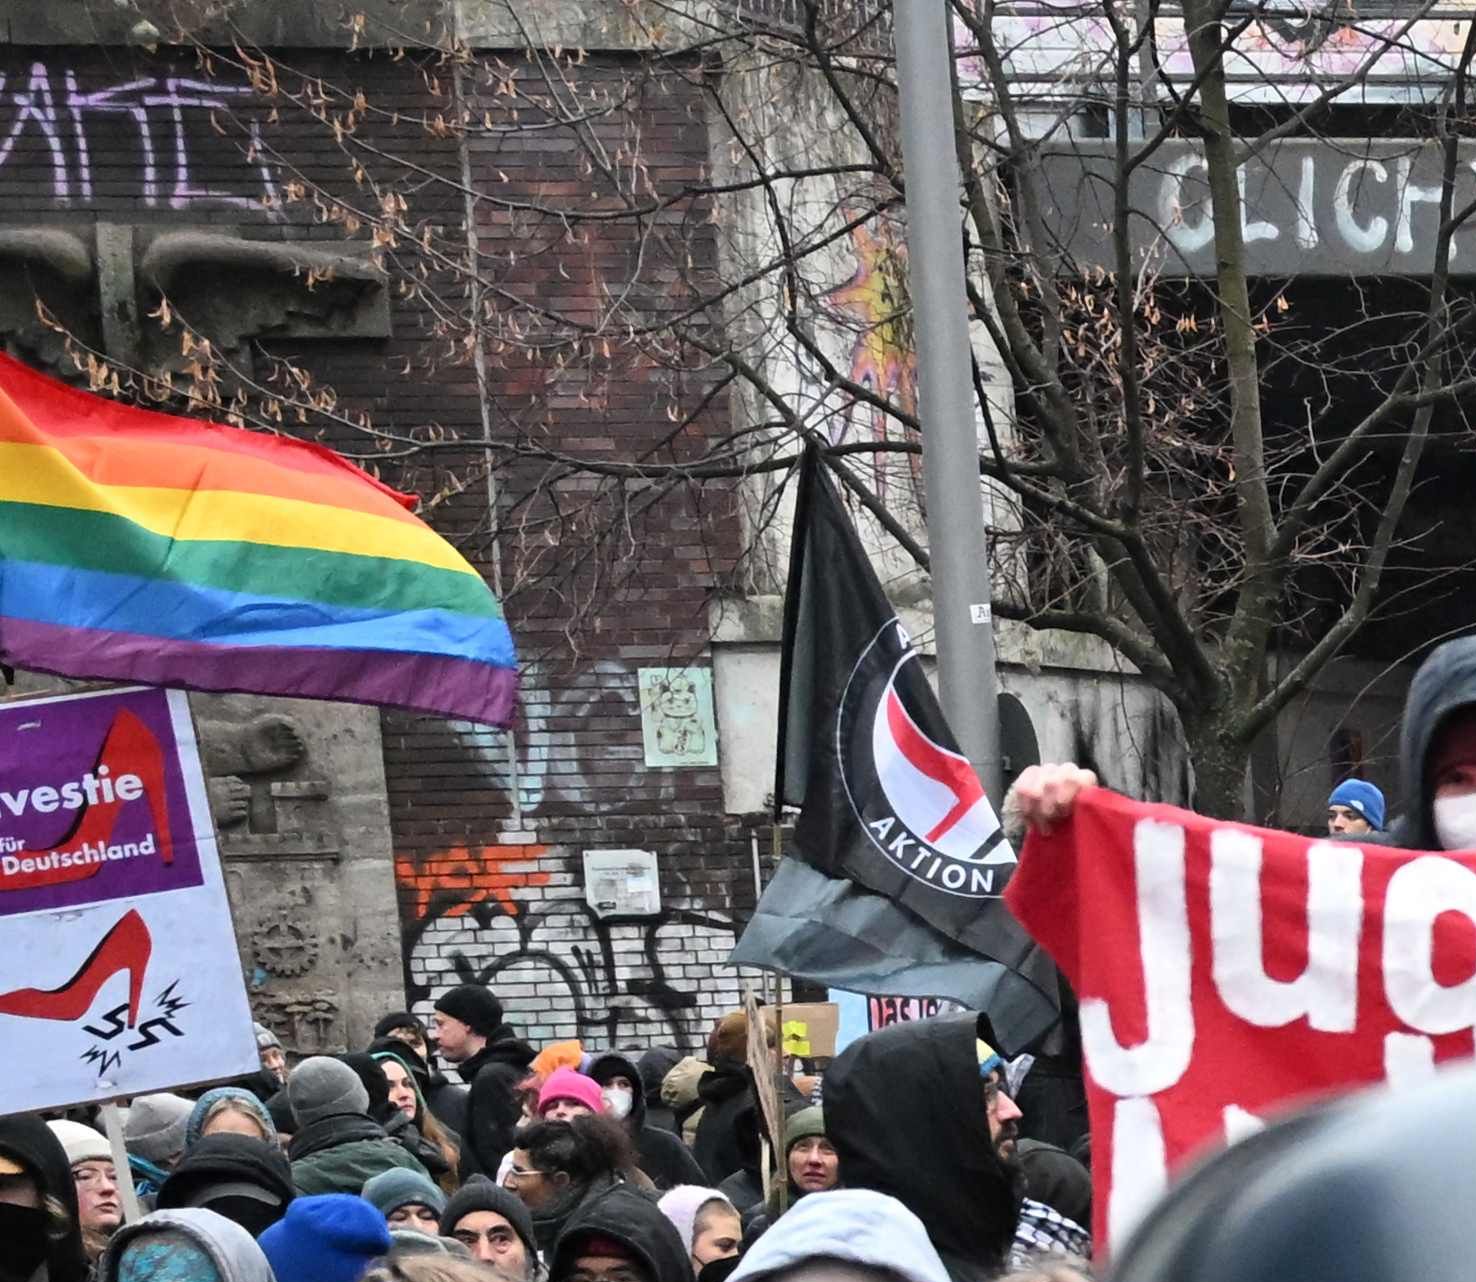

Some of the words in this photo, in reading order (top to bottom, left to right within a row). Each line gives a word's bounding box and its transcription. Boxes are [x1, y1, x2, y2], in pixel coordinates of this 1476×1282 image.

[0, 764, 144, 818] vestie
[1, 833, 156, 876] Deutschland
[868, 811, 997, 893] AKTION
